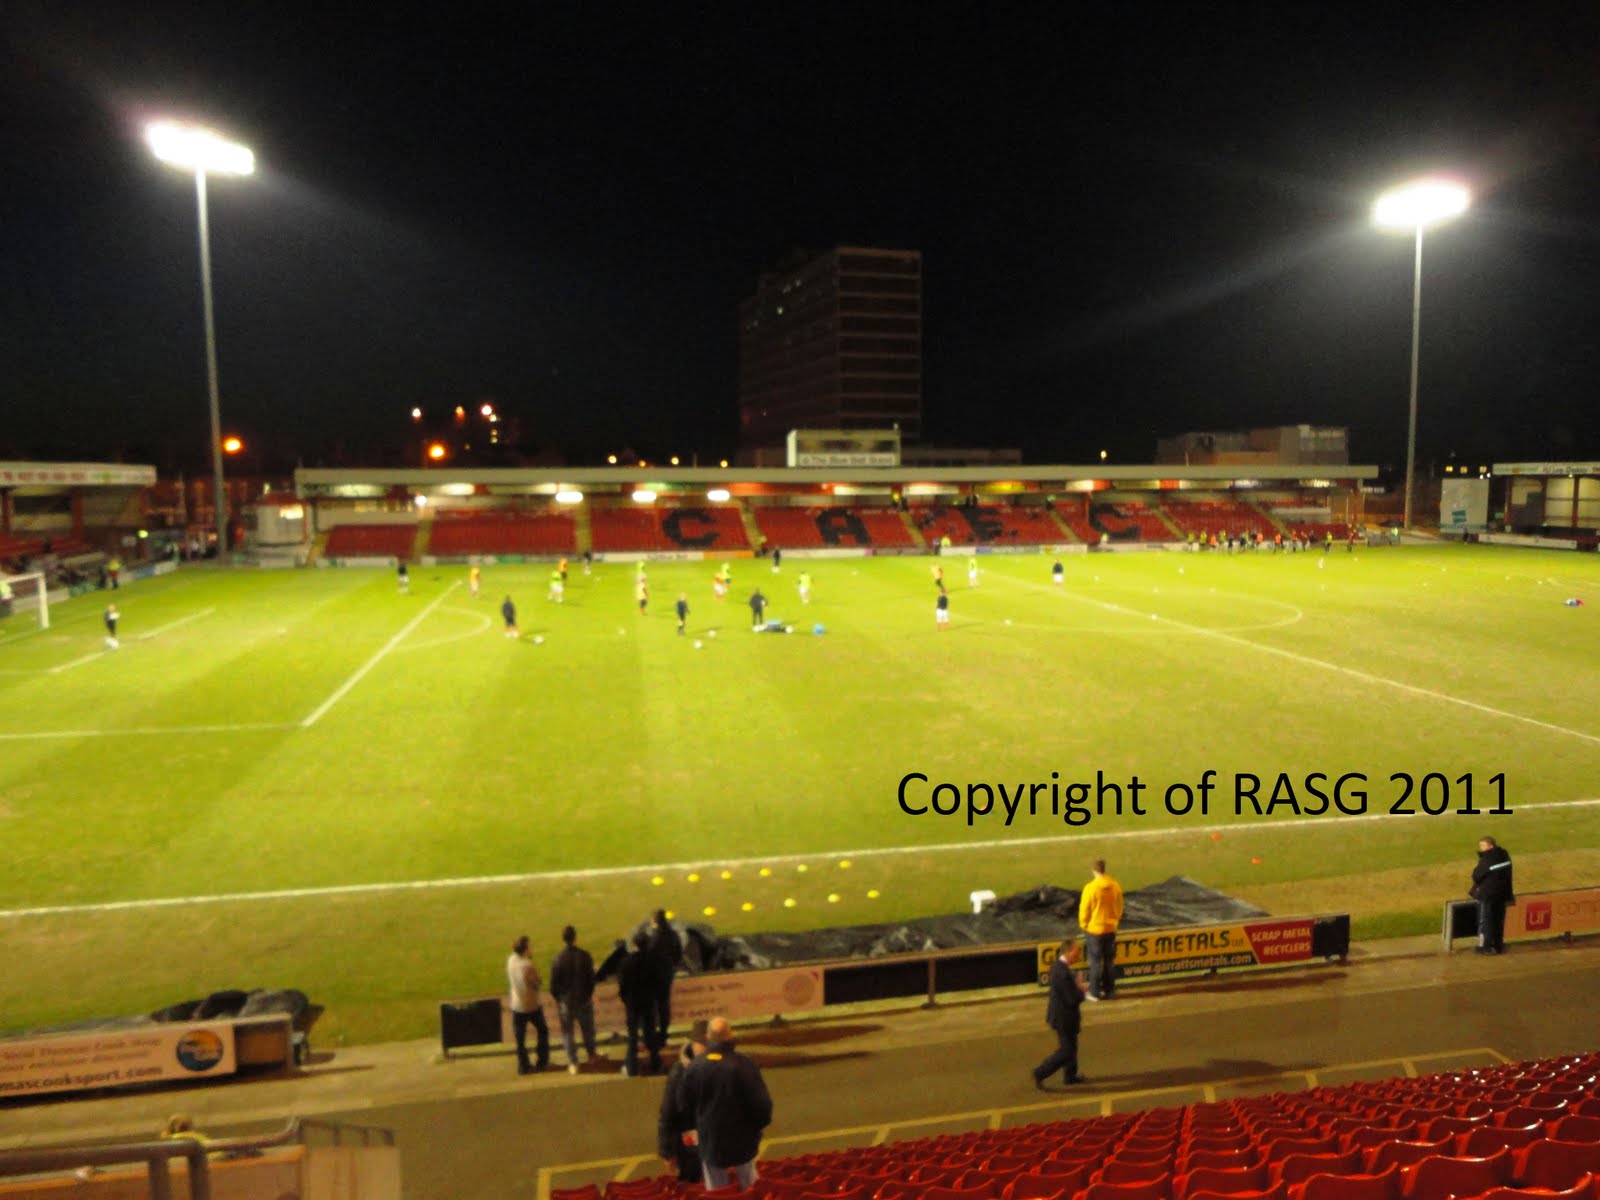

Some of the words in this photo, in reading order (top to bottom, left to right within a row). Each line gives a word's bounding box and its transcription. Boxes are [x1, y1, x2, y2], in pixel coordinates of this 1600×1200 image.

[1251, 930, 1281, 942] SCRAP
[1282, 927, 1311, 939] METAL
[1154, 930, 1230, 955] METALS
[1263, 942, 1311, 956] RECYCLERS
